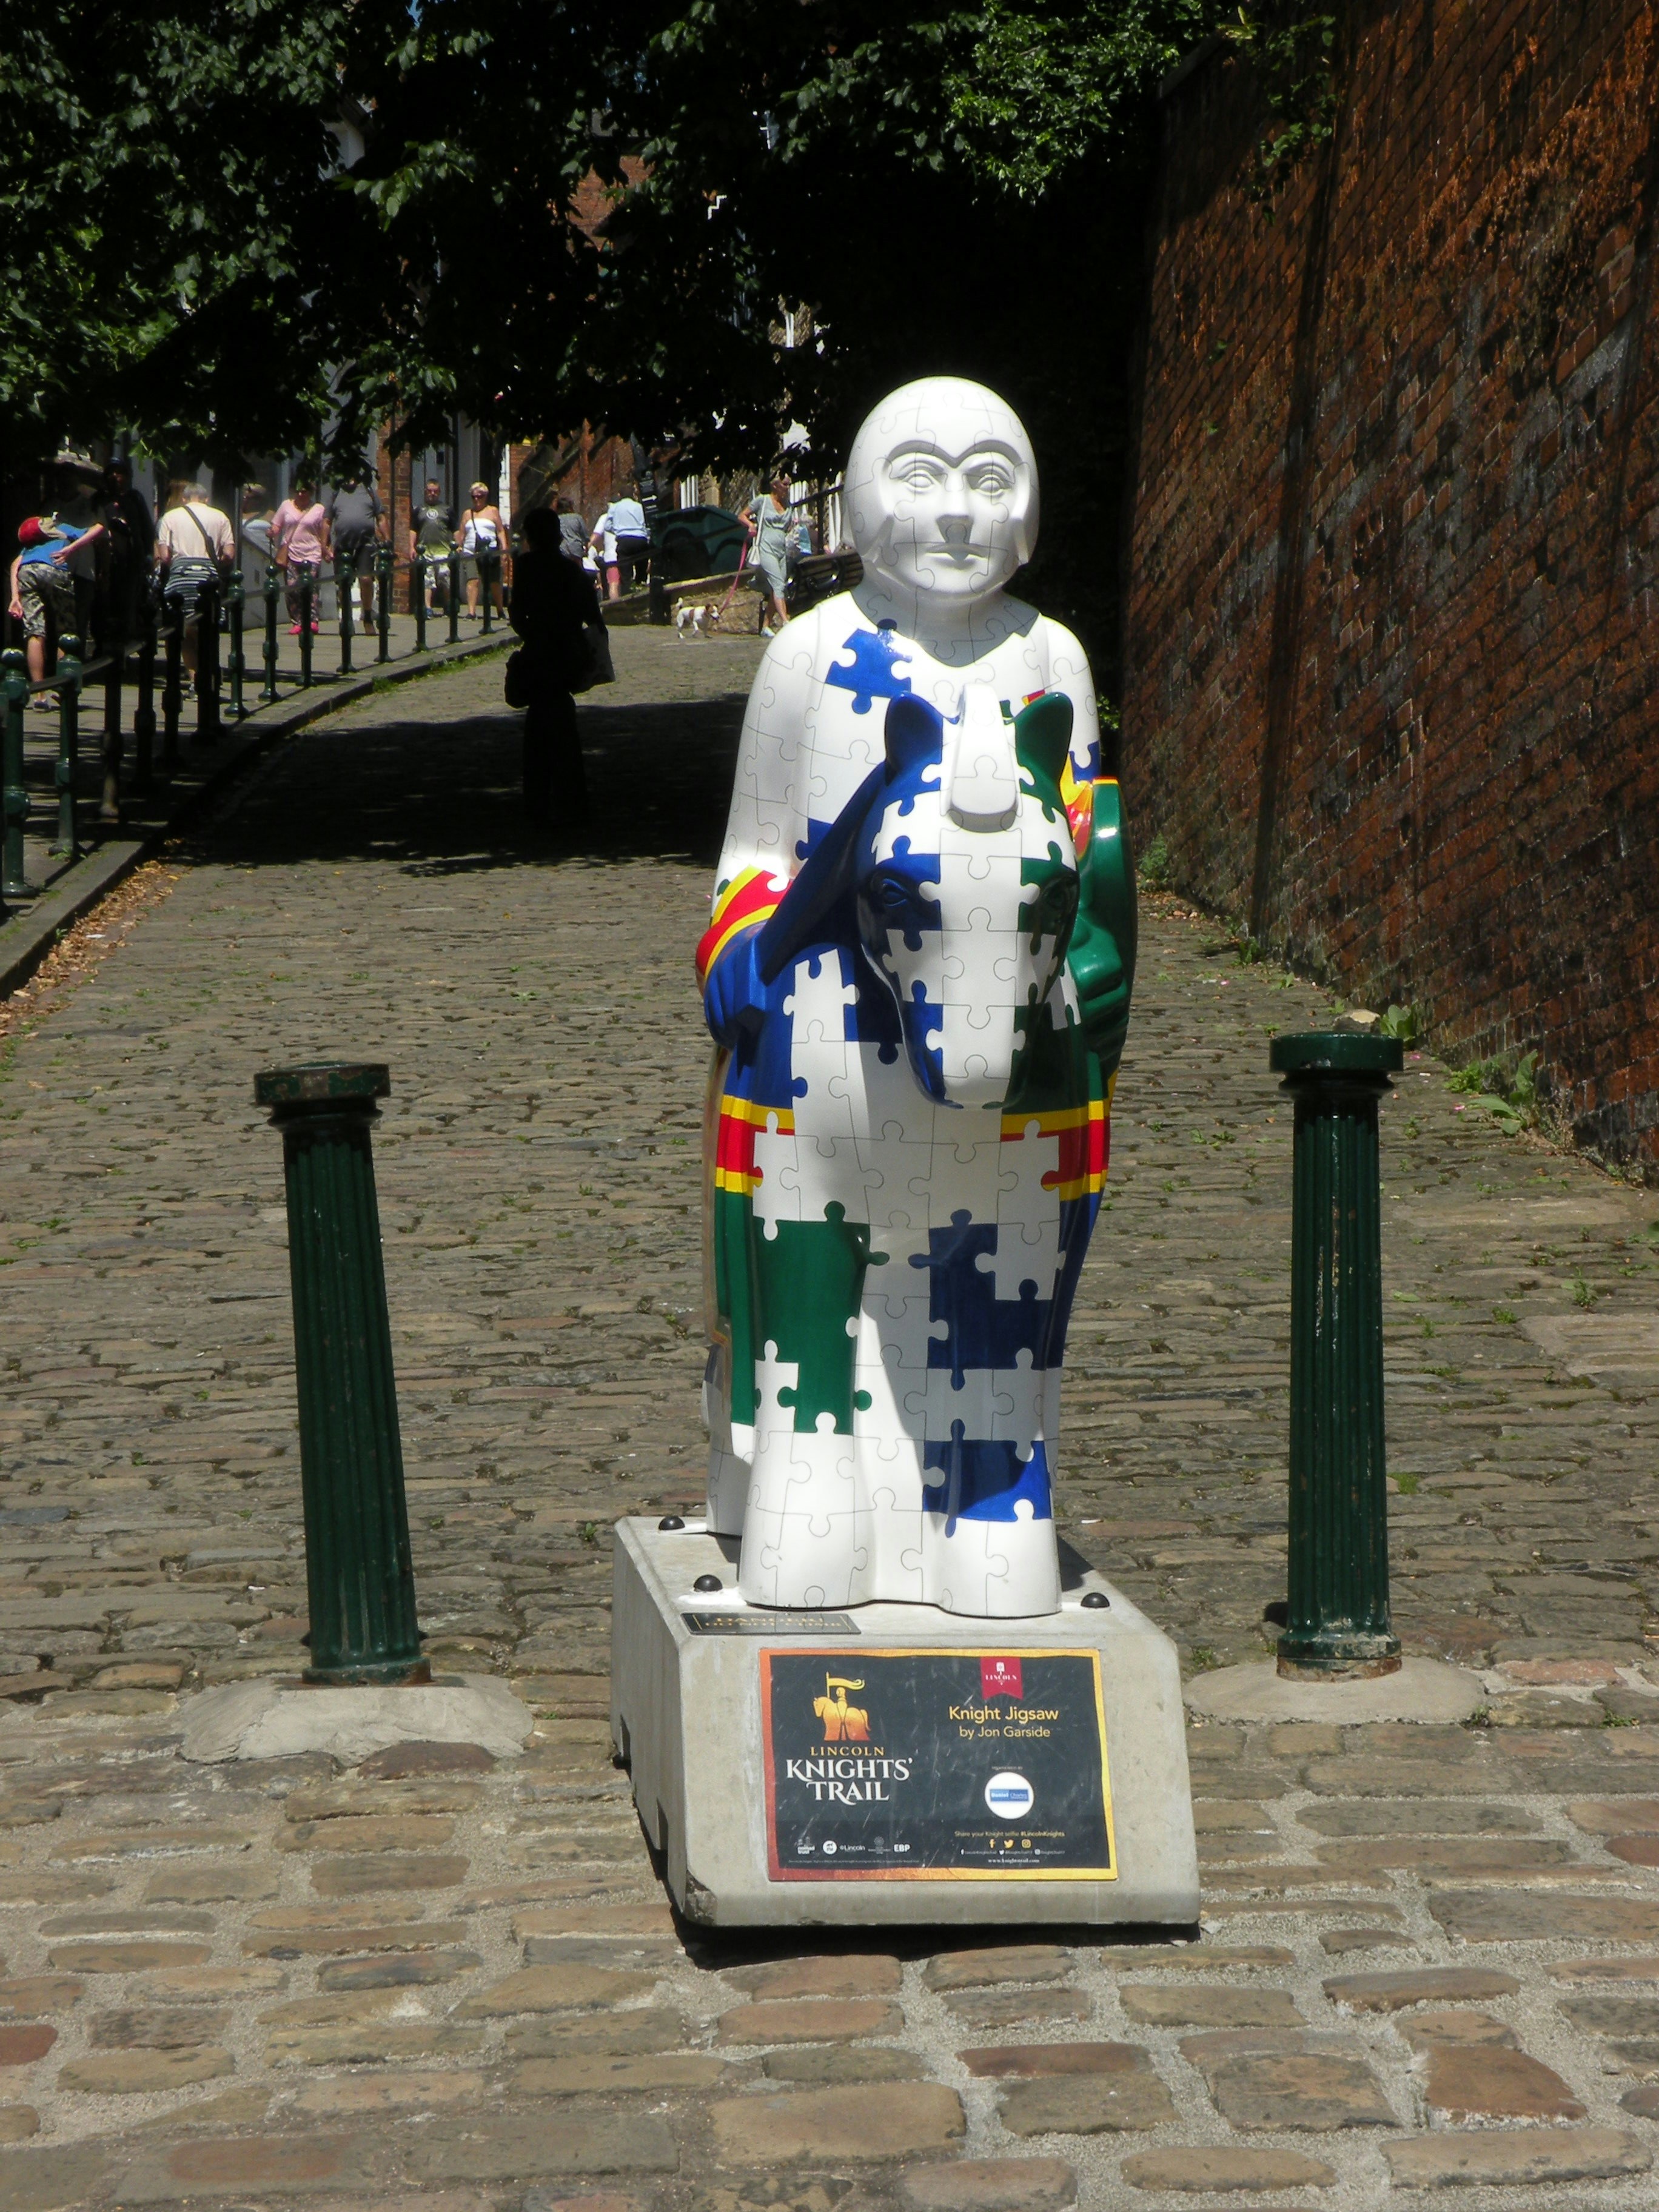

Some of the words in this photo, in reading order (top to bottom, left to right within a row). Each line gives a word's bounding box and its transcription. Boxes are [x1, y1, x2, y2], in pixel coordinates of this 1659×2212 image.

[949, 1705, 1001, 1724] Knight
[1005, 1705, 1059, 1724] Jigsaw
[959, 1726, 974, 1740] by
[977, 1726, 1000, 1737] Jon
[1004, 1726, 1051, 1737] Garside
[810, 1746, 885, 1757] LINCOLN
[806, 1781, 890, 1806] TRAIL
[893, 1843, 911, 1852] EBP
